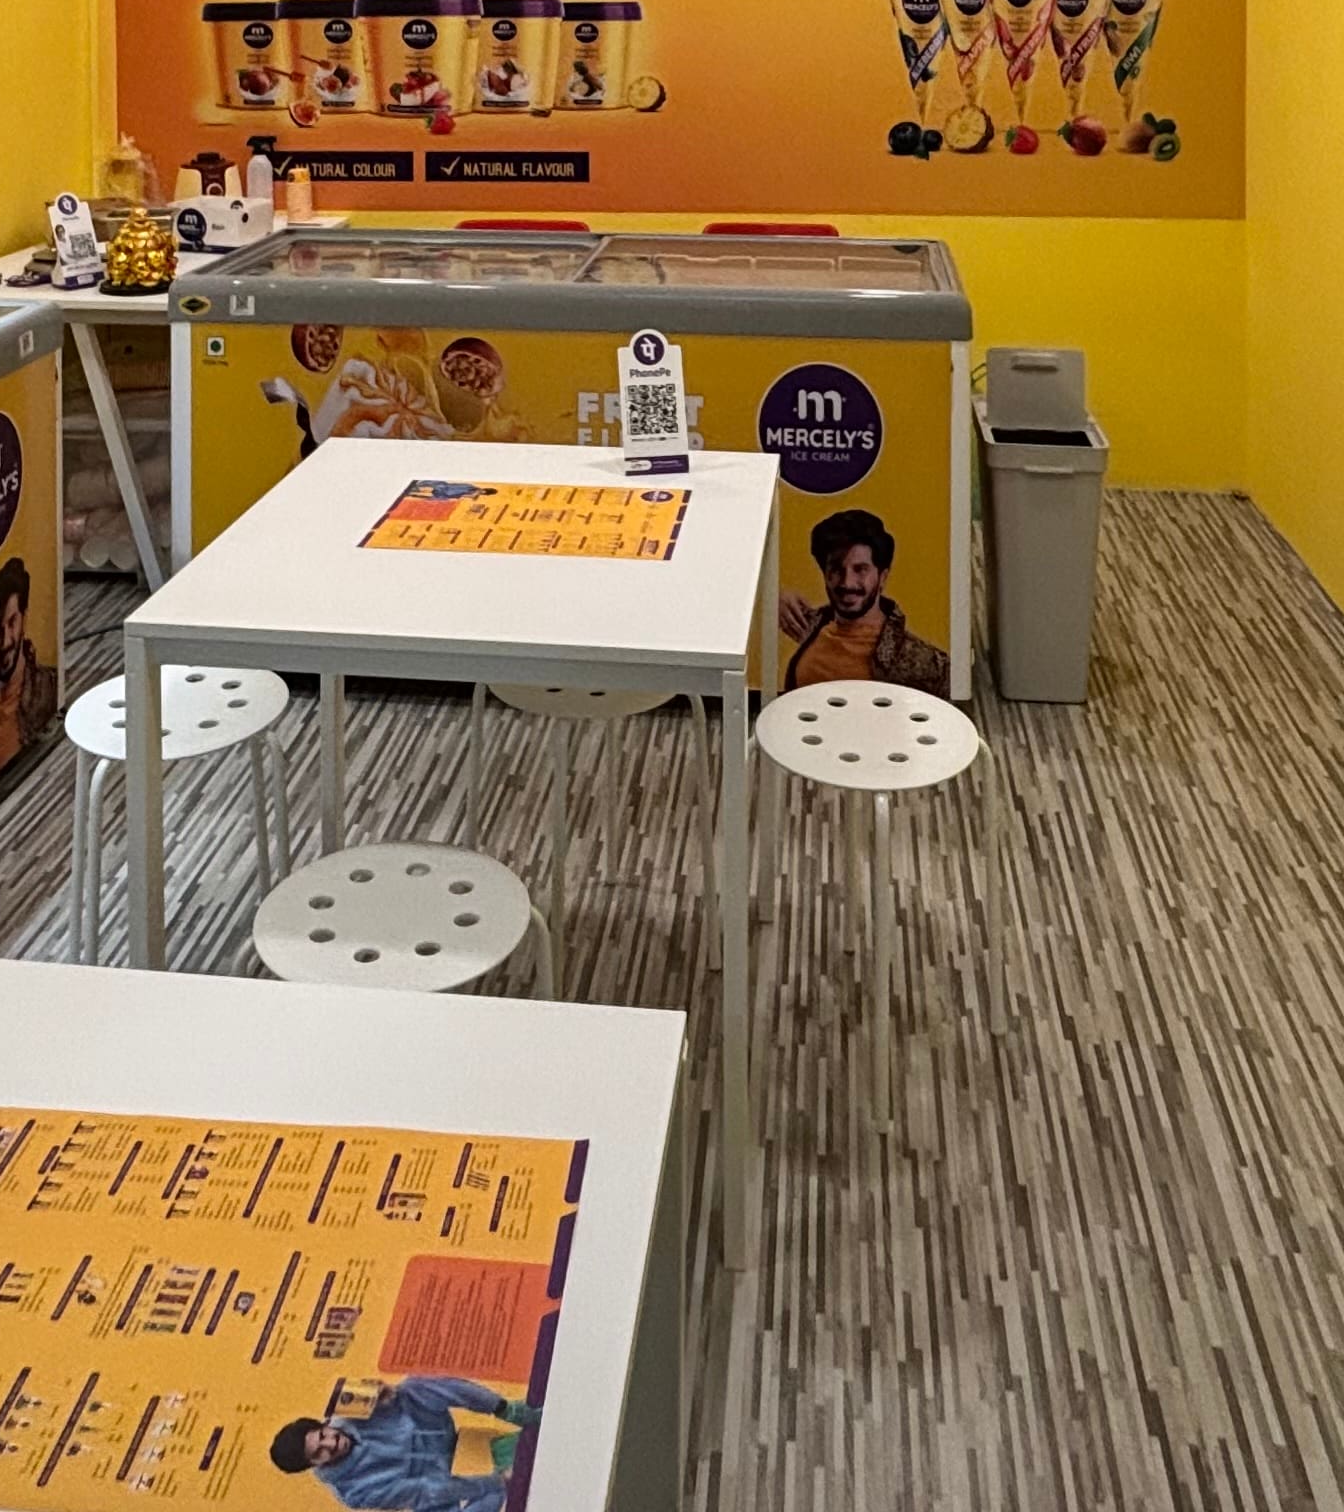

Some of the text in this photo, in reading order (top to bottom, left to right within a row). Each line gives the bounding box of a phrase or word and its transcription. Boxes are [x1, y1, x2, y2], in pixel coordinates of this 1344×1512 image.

[353, 162, 396, 177] COLOUR
[463, 162, 574, 176] NATURAL FLAVOUR
[629, 367, 671, 379] PhonePe
[577, 391, 704, 426] FRT
[766, 427, 874, 449] MERCELY'S
[812, 451, 850, 462] CREAM
